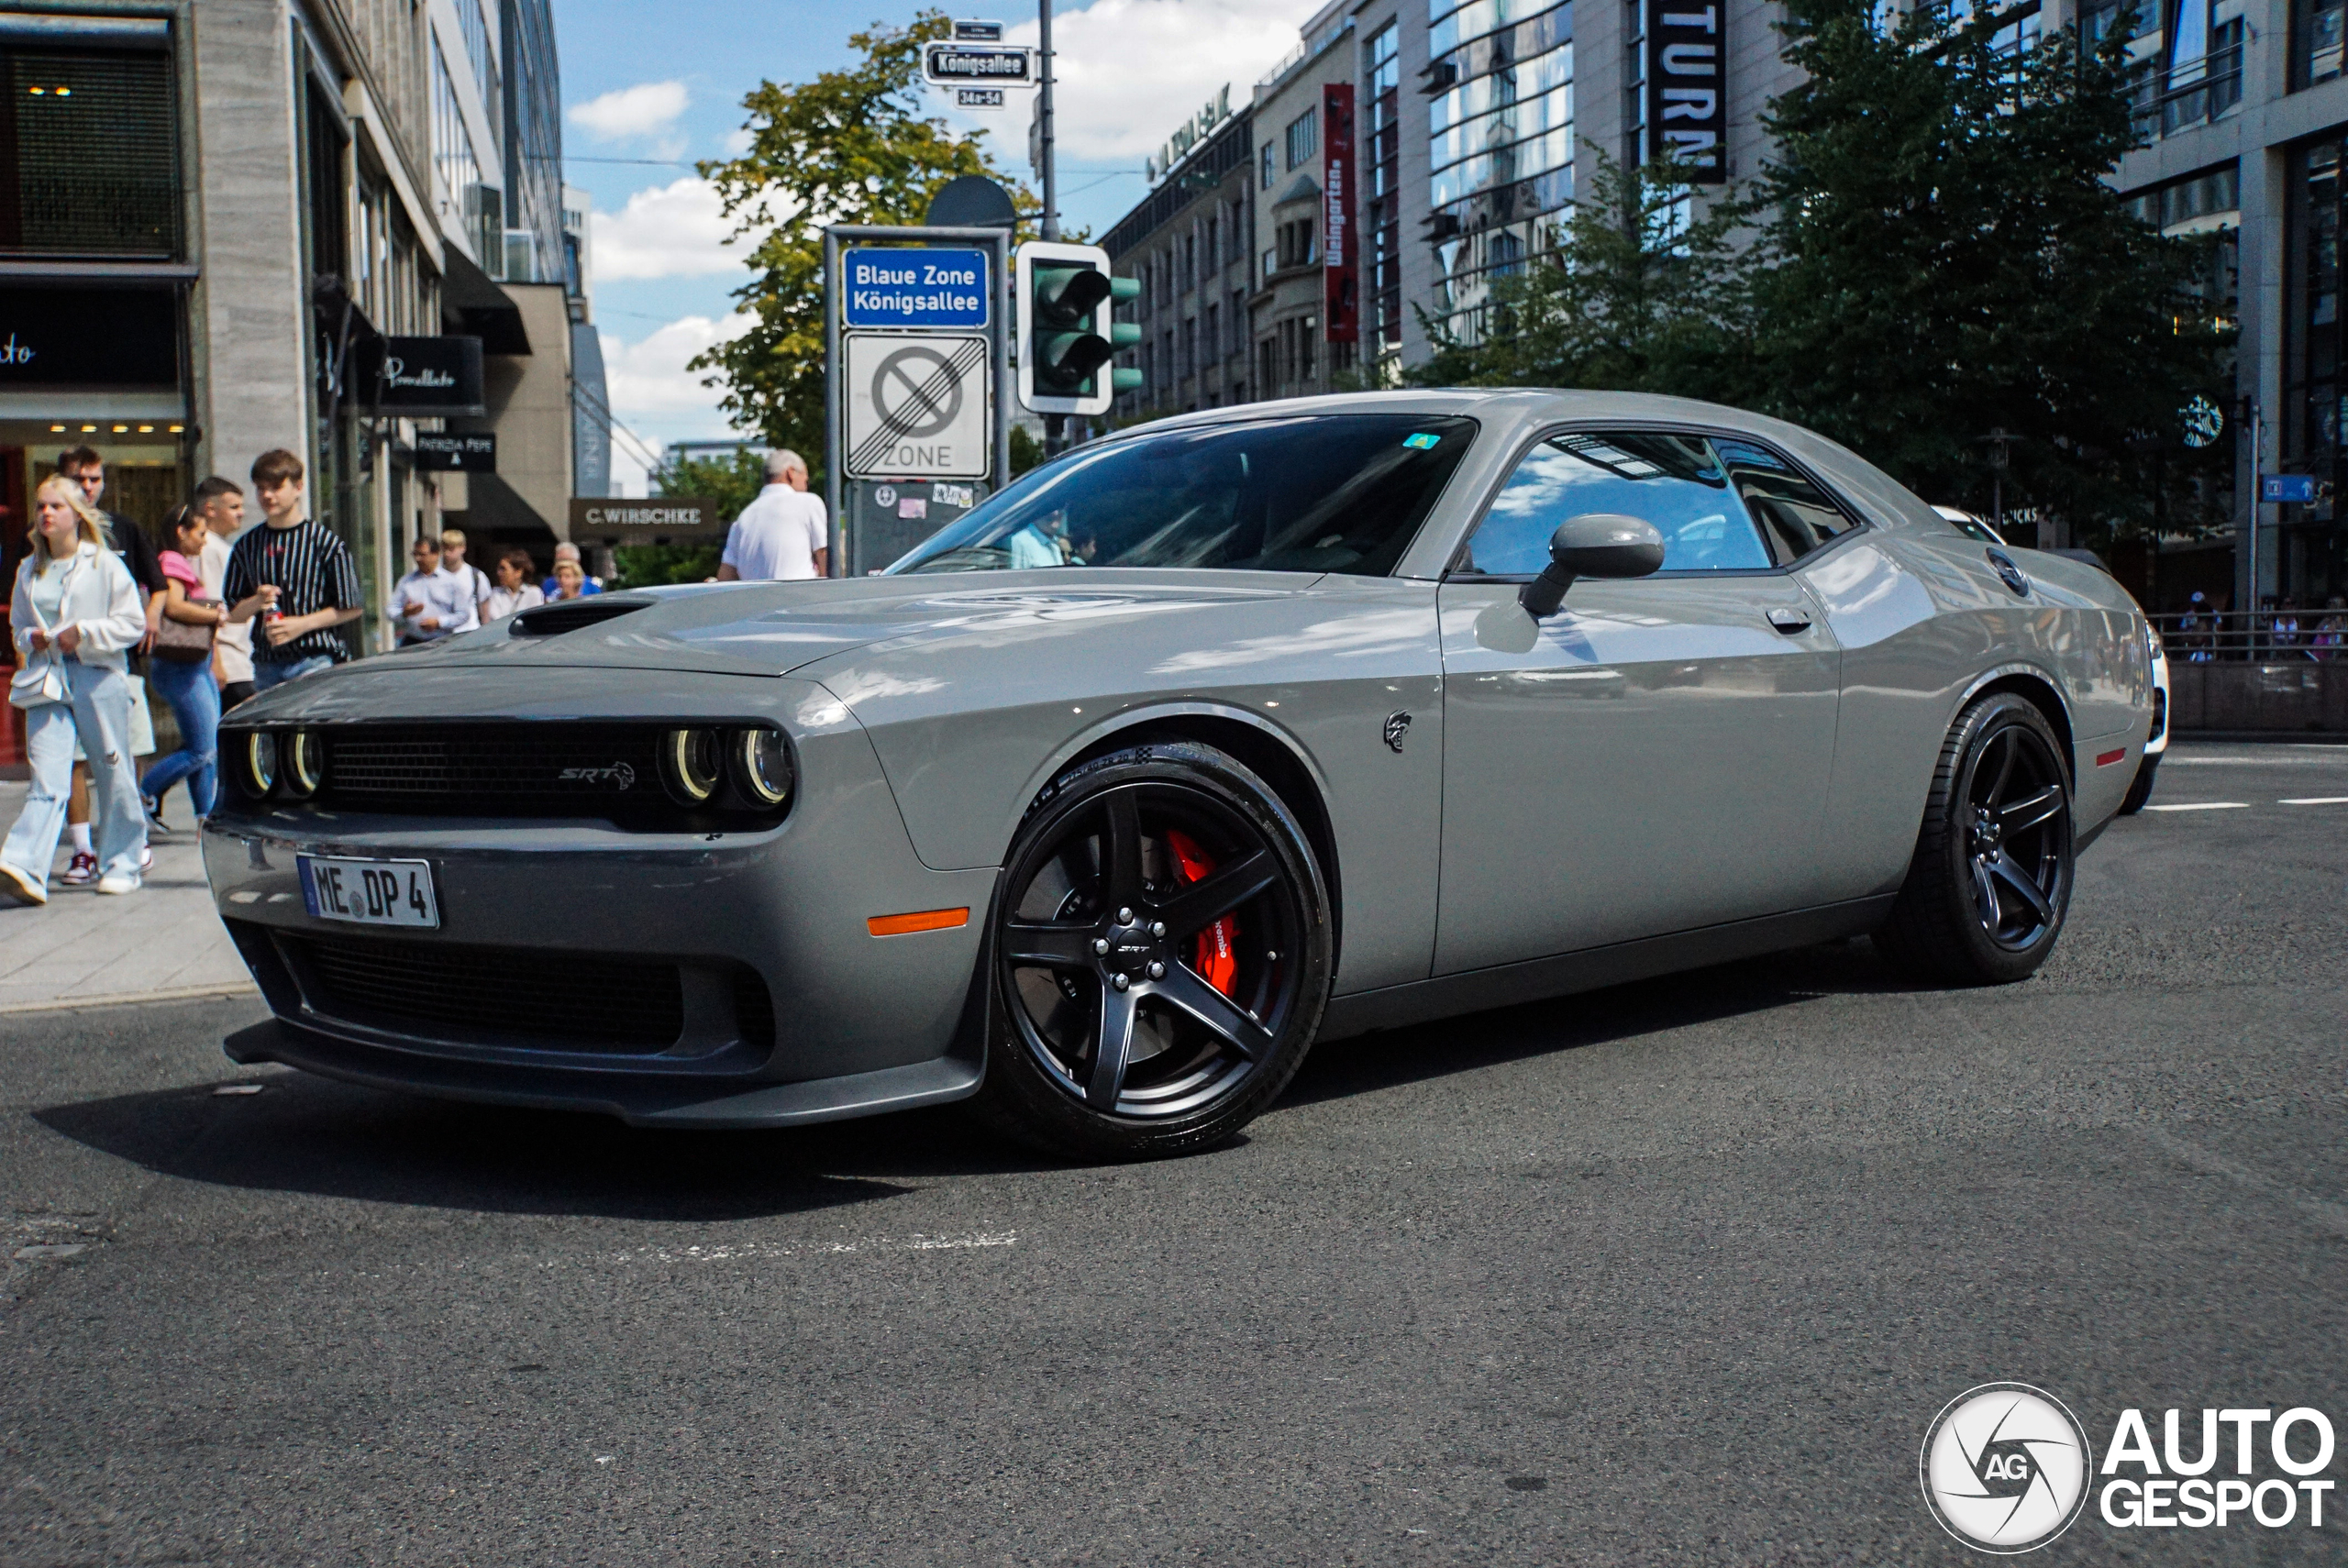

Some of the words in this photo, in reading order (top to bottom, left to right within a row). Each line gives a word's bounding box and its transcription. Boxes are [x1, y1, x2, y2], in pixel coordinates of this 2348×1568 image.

[937, 53, 1022, 76] Königsallee
[960, 92, 1001, 105] 34a-54
[856, 264, 917, 285] Blaue
[924, 265, 976, 285] Zone
[854, 291, 979, 315] Königsallee
[883, 446, 951, 467] ZONE
[558, 768, 618, 783] SRT
[315, 866, 349, 914] ME
[361, 869, 399, 918] DP
[409, 871, 426, 919] 4
